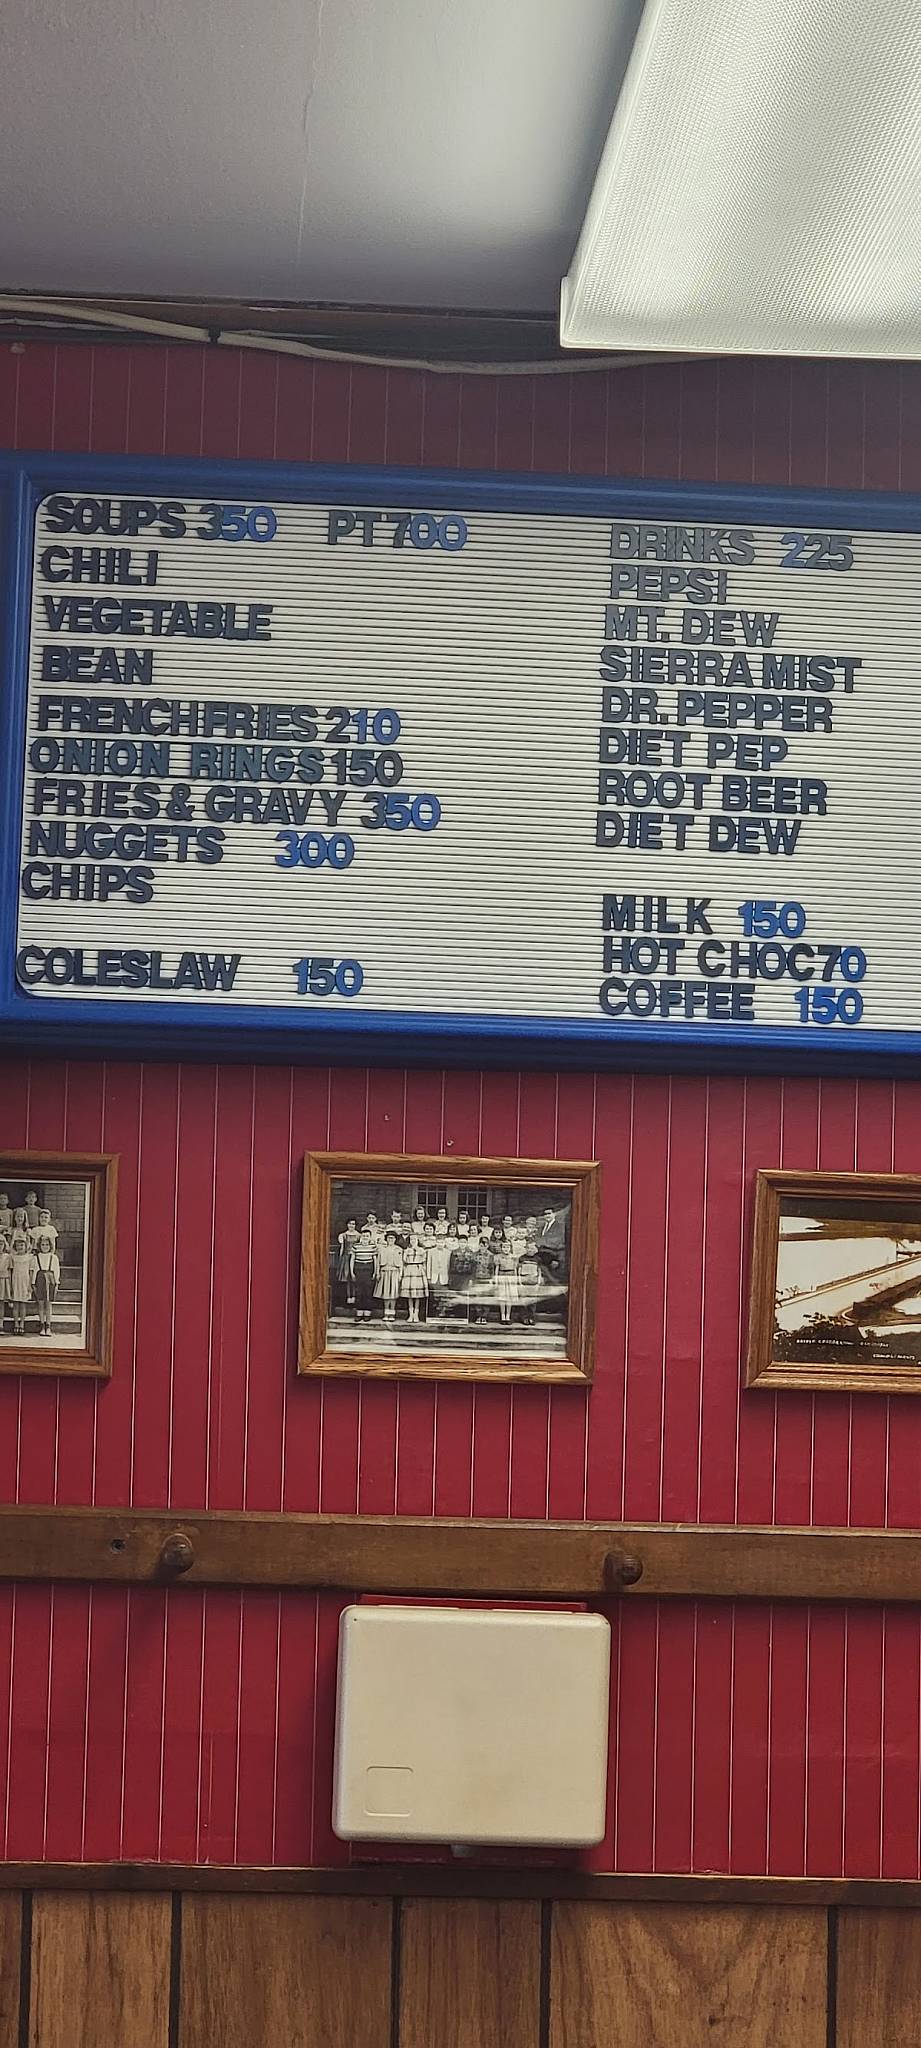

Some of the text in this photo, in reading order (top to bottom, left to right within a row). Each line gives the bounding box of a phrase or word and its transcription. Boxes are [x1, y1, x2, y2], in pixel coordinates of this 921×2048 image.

[44, 496, 468, 551] SOUPS 350 PT 700
[40, 545, 159, 587] CHILI
[610, 523, 854, 571] DRINKS 225
[610, 564, 728, 605] PEPSI
[42, 595, 273, 641] VEGETABLE
[605, 604, 780, 648] MT. DEW
[41, 645, 154, 685] BEAN
[599, 645, 862, 693] SIERRA MIST
[324, 706, 400, 745] 210
[602, 686, 833, 733] DR. PEPPER
[29, 737, 403, 787] ONION RINGS 150
[599, 727, 789, 771] DIET PEP
[34, 777, 441, 831] FRIES & GRAVY 350
[599, 769, 828, 815] ROOT BEER
[29, 820, 355, 870] NUGGETS 300
[595, 810, 801, 855] DIET DEW
[21, 861, 155, 904] CHIPS
[602, 894, 806, 939] MILK 150
[16, 945, 364, 996] COLESLAW 150
[602, 936, 867, 983] HOT CHOC 70
[599, 977, 864, 1024] COFFEE 150
